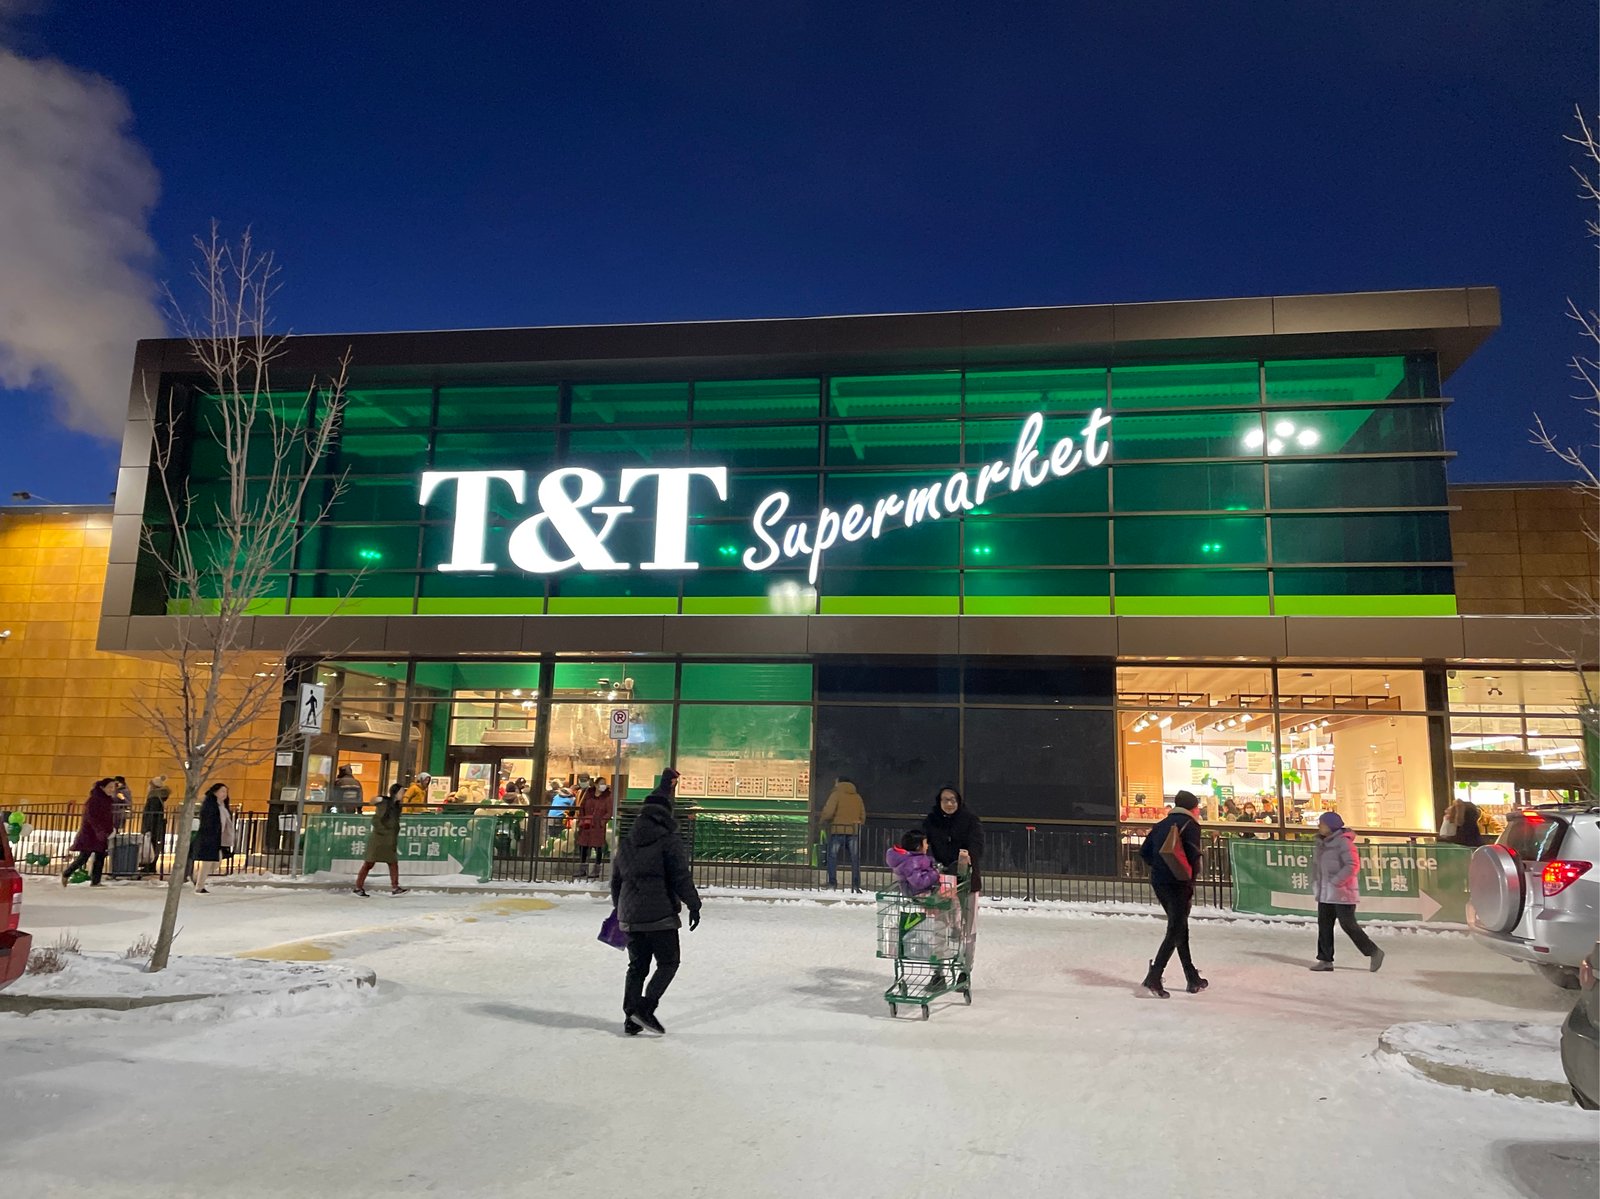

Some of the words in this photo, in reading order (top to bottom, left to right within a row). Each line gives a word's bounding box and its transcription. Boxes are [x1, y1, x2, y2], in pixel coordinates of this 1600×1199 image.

[419, 465, 728, 574] T&T
[743, 406, 1113, 584] Supermarket
[1261, 743, 1270, 752] 1A
[333, 821, 366, 836] Line
[398, 822, 468, 837] Entrance
[1266, 850, 1308, 868] Line
[1359, 854, 1438, 870] ntrance
